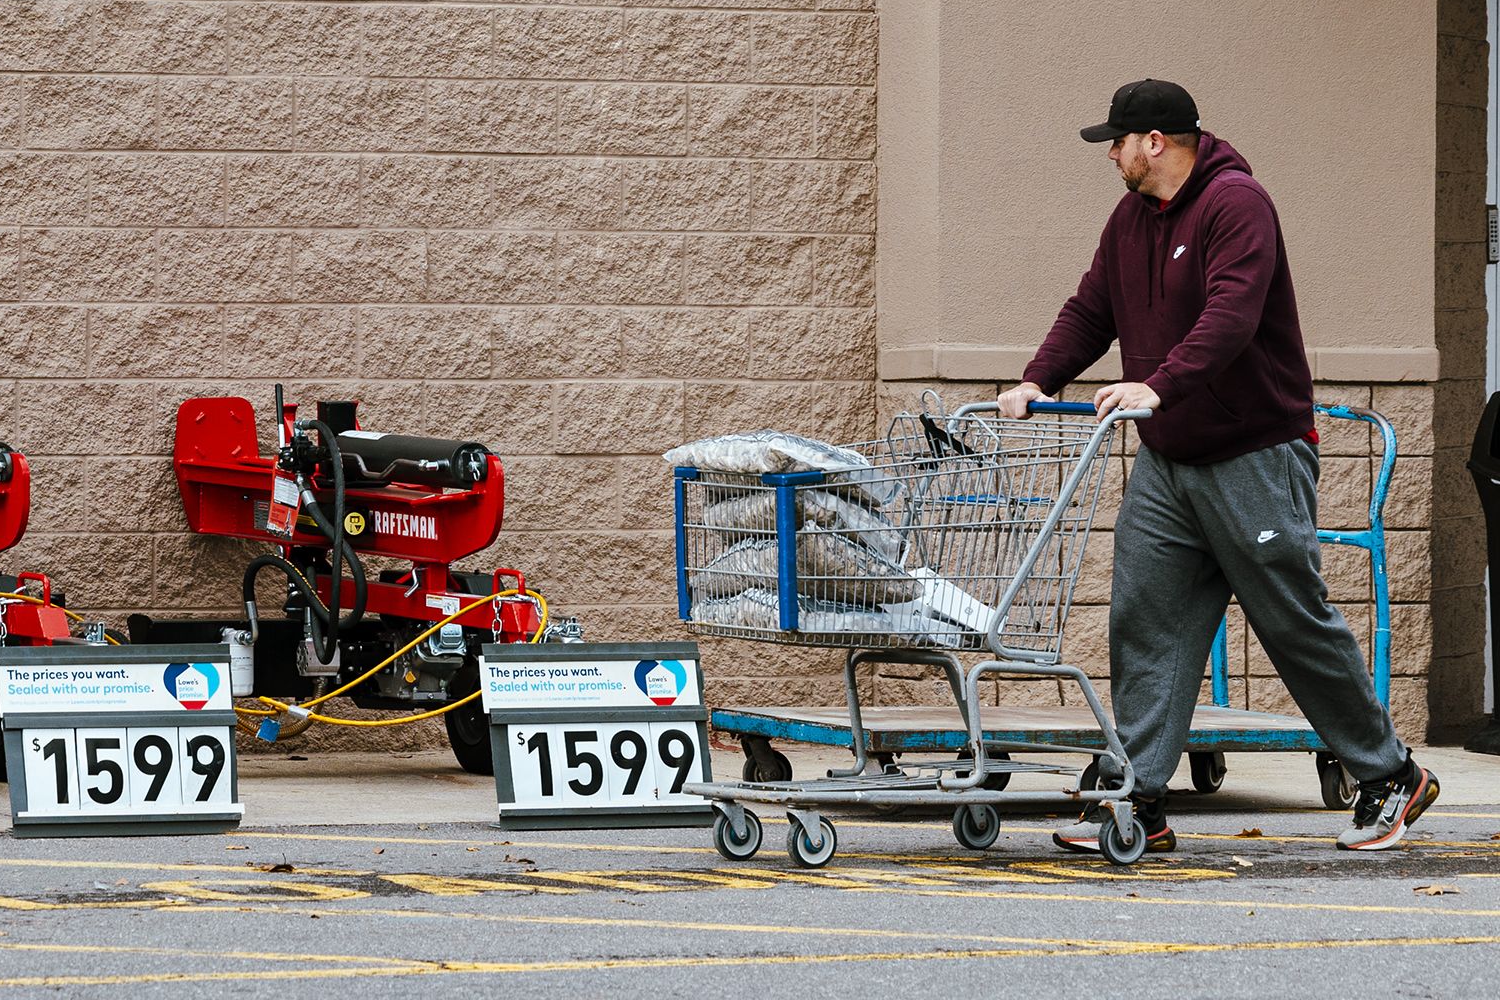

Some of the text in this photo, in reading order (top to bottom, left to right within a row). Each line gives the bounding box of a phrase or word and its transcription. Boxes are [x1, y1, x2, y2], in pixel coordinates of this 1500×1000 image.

[7, 669, 129, 682] The prices you want.
[489, 667, 602, 679] The prices you want.
[8, 683, 154, 696] Sealed with our promise.
[490, 680, 626, 692] Sealed with our promise.
